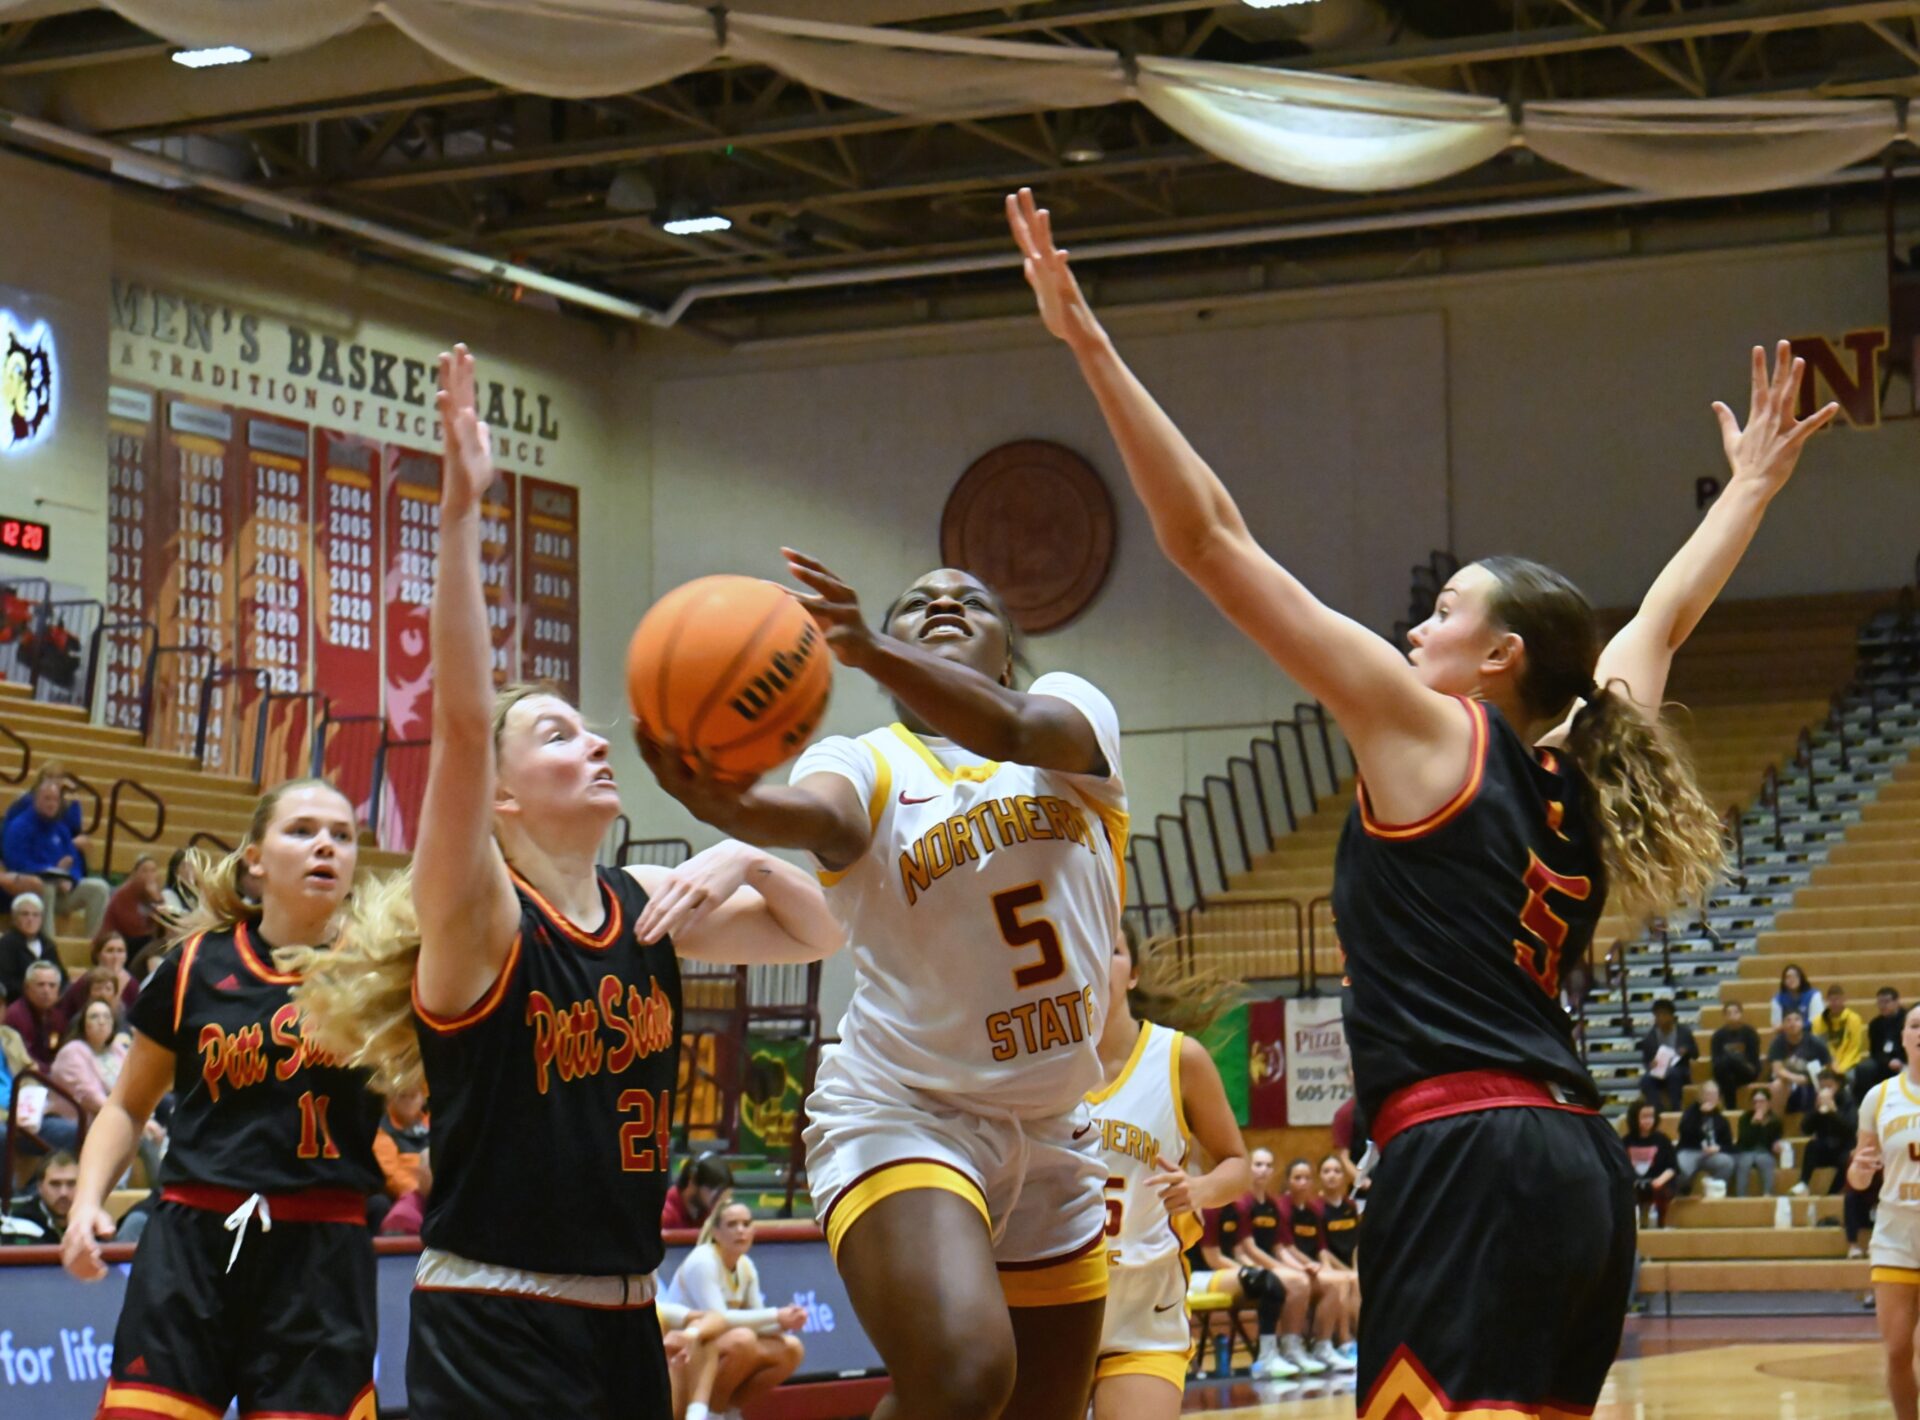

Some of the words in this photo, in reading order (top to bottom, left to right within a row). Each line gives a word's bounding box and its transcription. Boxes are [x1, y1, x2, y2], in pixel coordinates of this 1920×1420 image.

[106, 278, 260, 364] MEN'S
[288, 325, 558, 441] BASKEALL
[120, 345, 134, 366] A
[150, 350, 318, 410] TRADITION
[332, 395, 364, 421] OF
[378, 406, 546, 467] EXCENCE
[329, 482, 371, 514] 2004
[178, 592, 222, 624] 1971
[329, 592, 372, 623] 2020
[400, 577, 434, 606] 202
[255, 607, 300, 638] 2020
[329, 619, 370, 651] 2021
[255, 635, 299, 667] 2021
[899, 795, 1098, 906] NORTHERN
[989, 880, 1068, 990] 5
[1513, 846, 1592, 999] 5
[198, 1022, 268, 1104] Pitt
[527, 990, 603, 1095] Pitt
[1294, 1029, 1343, 1054] Pizza
[0, 1329, 54, 1386] for
[60, 1326, 114, 1382] life
